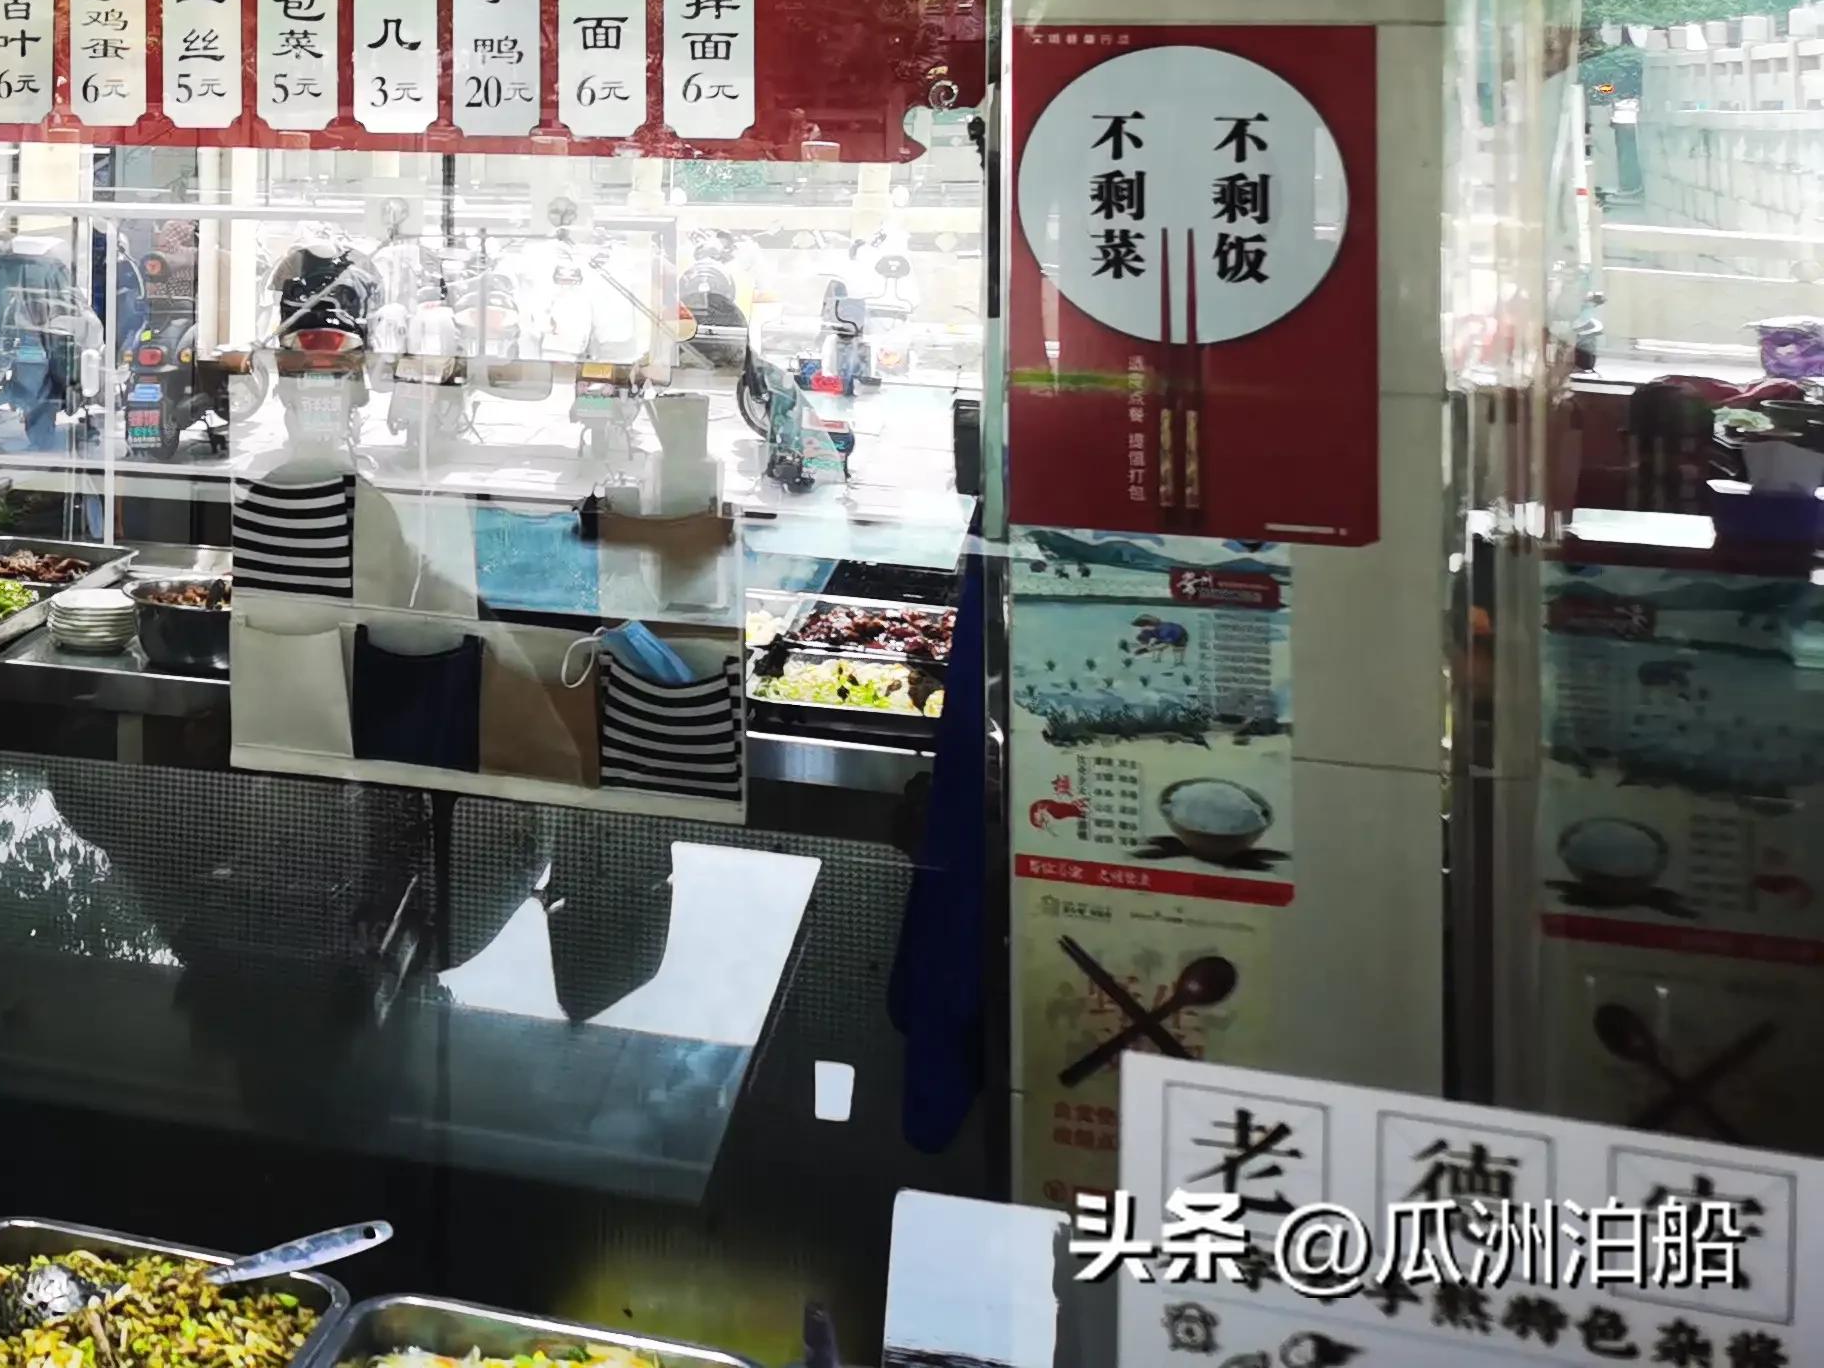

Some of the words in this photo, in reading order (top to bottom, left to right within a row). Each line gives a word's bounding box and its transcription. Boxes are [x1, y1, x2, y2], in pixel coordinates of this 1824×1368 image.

[80, 73, 129, 104] 6元
[176, 74, 228, 104] 5元
[272, 73, 323, 103] 5元
[370, 76, 423, 107] 3元
[465, 75, 534, 109] 20元
[576, 74, 630, 107] 6元
[681, 71, 740, 103] 6元
[1090, 111, 1146, 280] 不剩菜
[1212, 112, 1270, 284] 不剩饭
